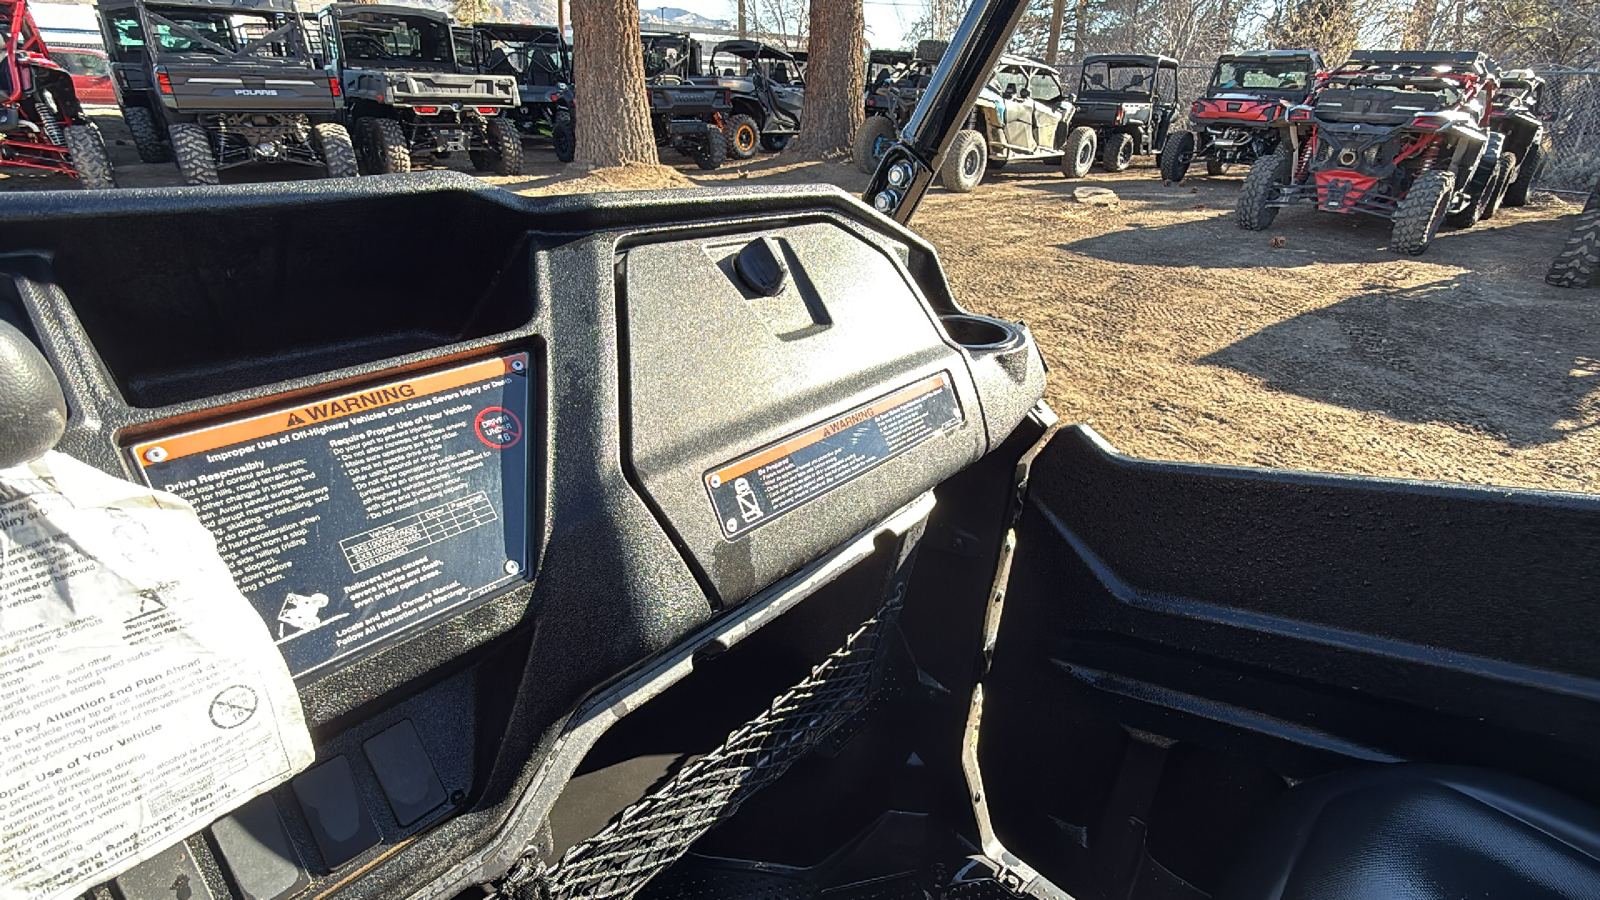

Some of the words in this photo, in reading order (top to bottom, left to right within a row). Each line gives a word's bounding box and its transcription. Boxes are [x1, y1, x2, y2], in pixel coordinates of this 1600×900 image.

[304, 384, 416, 421] WARNING
[206, 444, 256, 463] Improper
[256, 439, 278, 450] Use
[291, 421, 349, 441] Off-Highway
[349, 411, 387, 425] Vehicles
[387, 406, 406, 416] Can
[405, 400, 432, 411] Cause
[432, 392, 459, 404] Severe
[459, 386, 481, 397] Injury
[329, 433, 366, 450] Require
[365, 424, 396, 438] Proper
[396, 420, 414, 429] Use
[423, 412, 442, 422] Your
[442, 404, 472, 416] Vehicle
[829, 408, 874, 433] WARNING
[164, 479, 197, 494] Drive
[197, 460, 264, 484] Responsibly
[174, 488, 196, 501] void
[196, 484, 215, 494] loss
[226, 472, 254, 486] control
[256, 467, 271, 477] and
[201, 500, 224, 511] other
[225, 489, 261, 504] changes
[270, 478, 300, 490] traction
[301, 471, 316, 481] and
[236, 480, 260, 492] rough
[217, 511, 246, 525] abrupt
[293, 486, 329, 501] sideways
[314, 493, 330, 503] and
[228, 537, 249, 550] hard
[250, 522, 298, 542] acceleration
[298, 514, 321, 526] when
[240, 544, 262, 555] even
[262, 537, 282, 547] from
[289, 528, 309, 538] stop.
[241, 569, 266, 584] down
[265, 561, 292, 574] before
[343, 574, 382, 594] Rollovers
[381, 567, 401, 579] have
[401, 555, 428, 570] caused
[350, 586, 377, 601] severe
[376, 574, 406, 590] injuries
[406, 567, 421, 578] and
[354, 596, 374, 609] even
[385, 585, 399, 596] flat
[399, 578, 419, 590] open
[335, 621, 364, 638] Locate
[364, 613, 380, 626] and
[380, 604, 401, 618] Read
